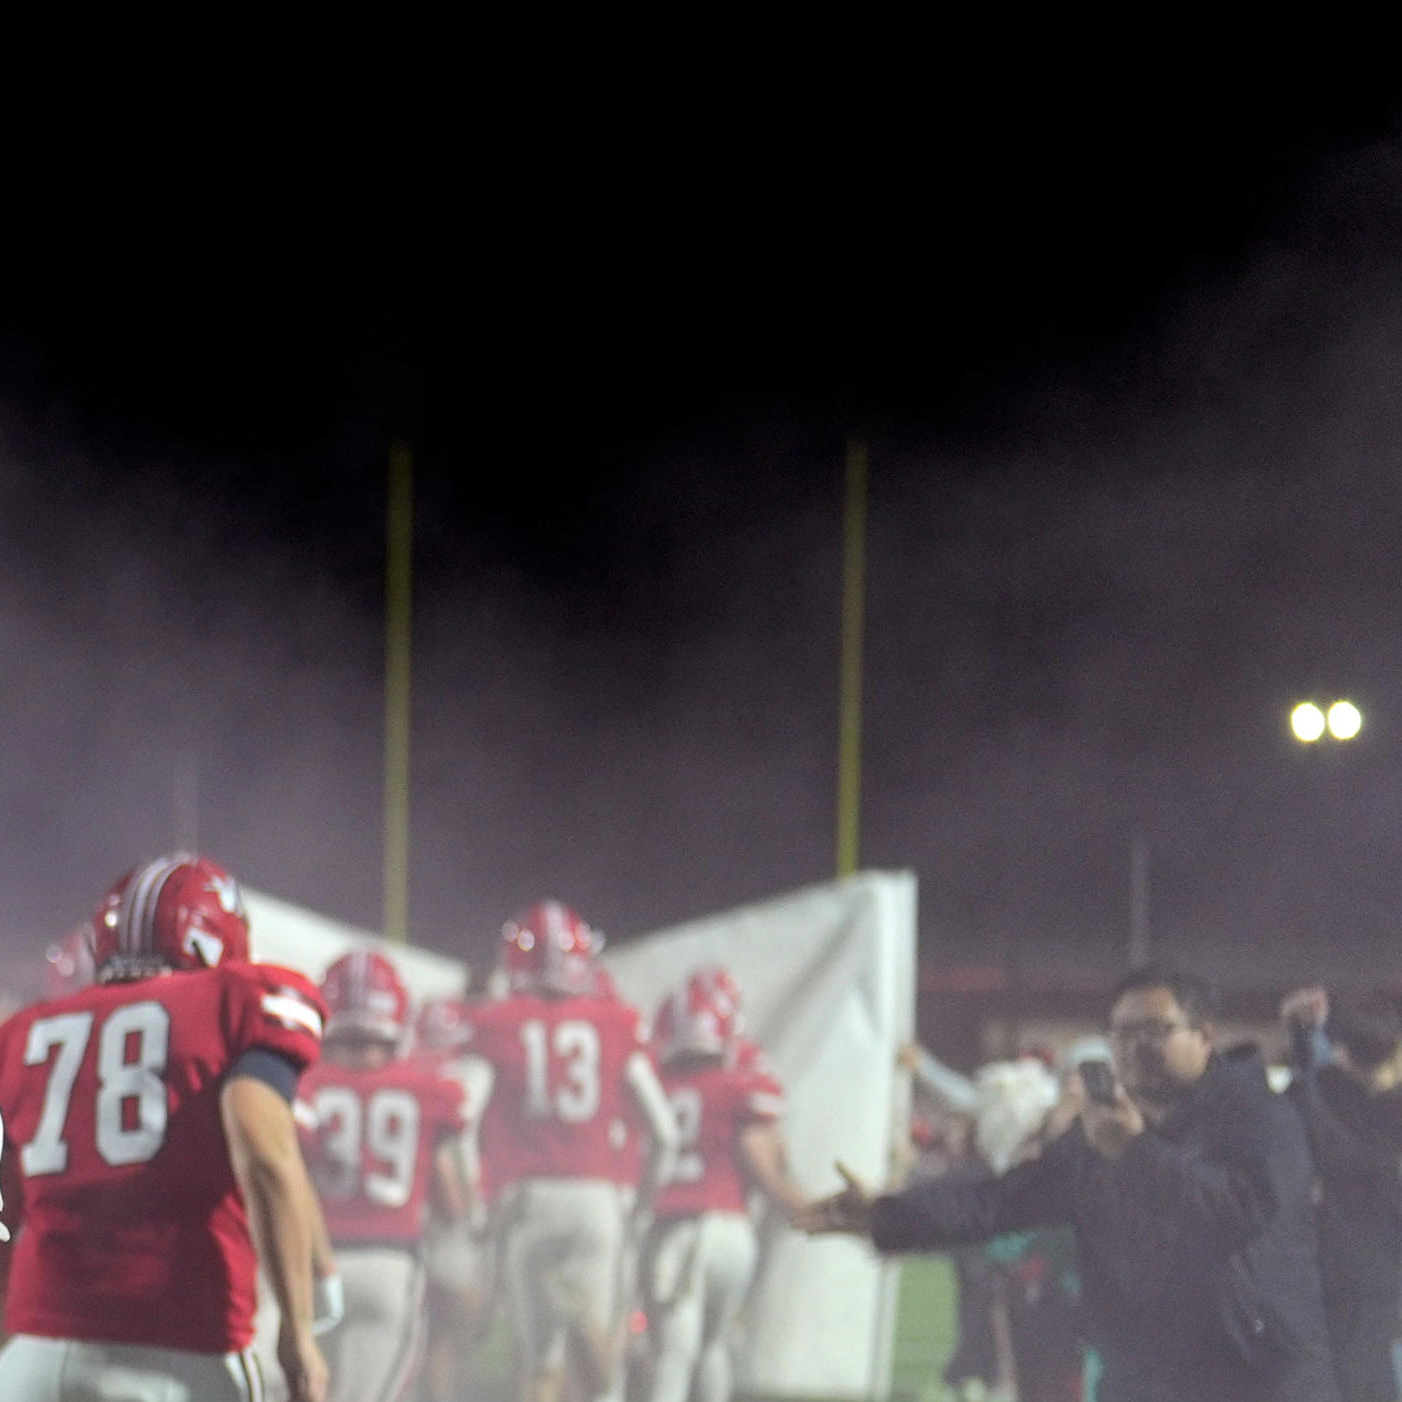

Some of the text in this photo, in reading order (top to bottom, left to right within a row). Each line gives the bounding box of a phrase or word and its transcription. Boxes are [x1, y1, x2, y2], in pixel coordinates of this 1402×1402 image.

[21, 1000, 171, 1178] 78
[518, 1018, 602, 1124] 13
[310, 1085, 423, 1208] 39
